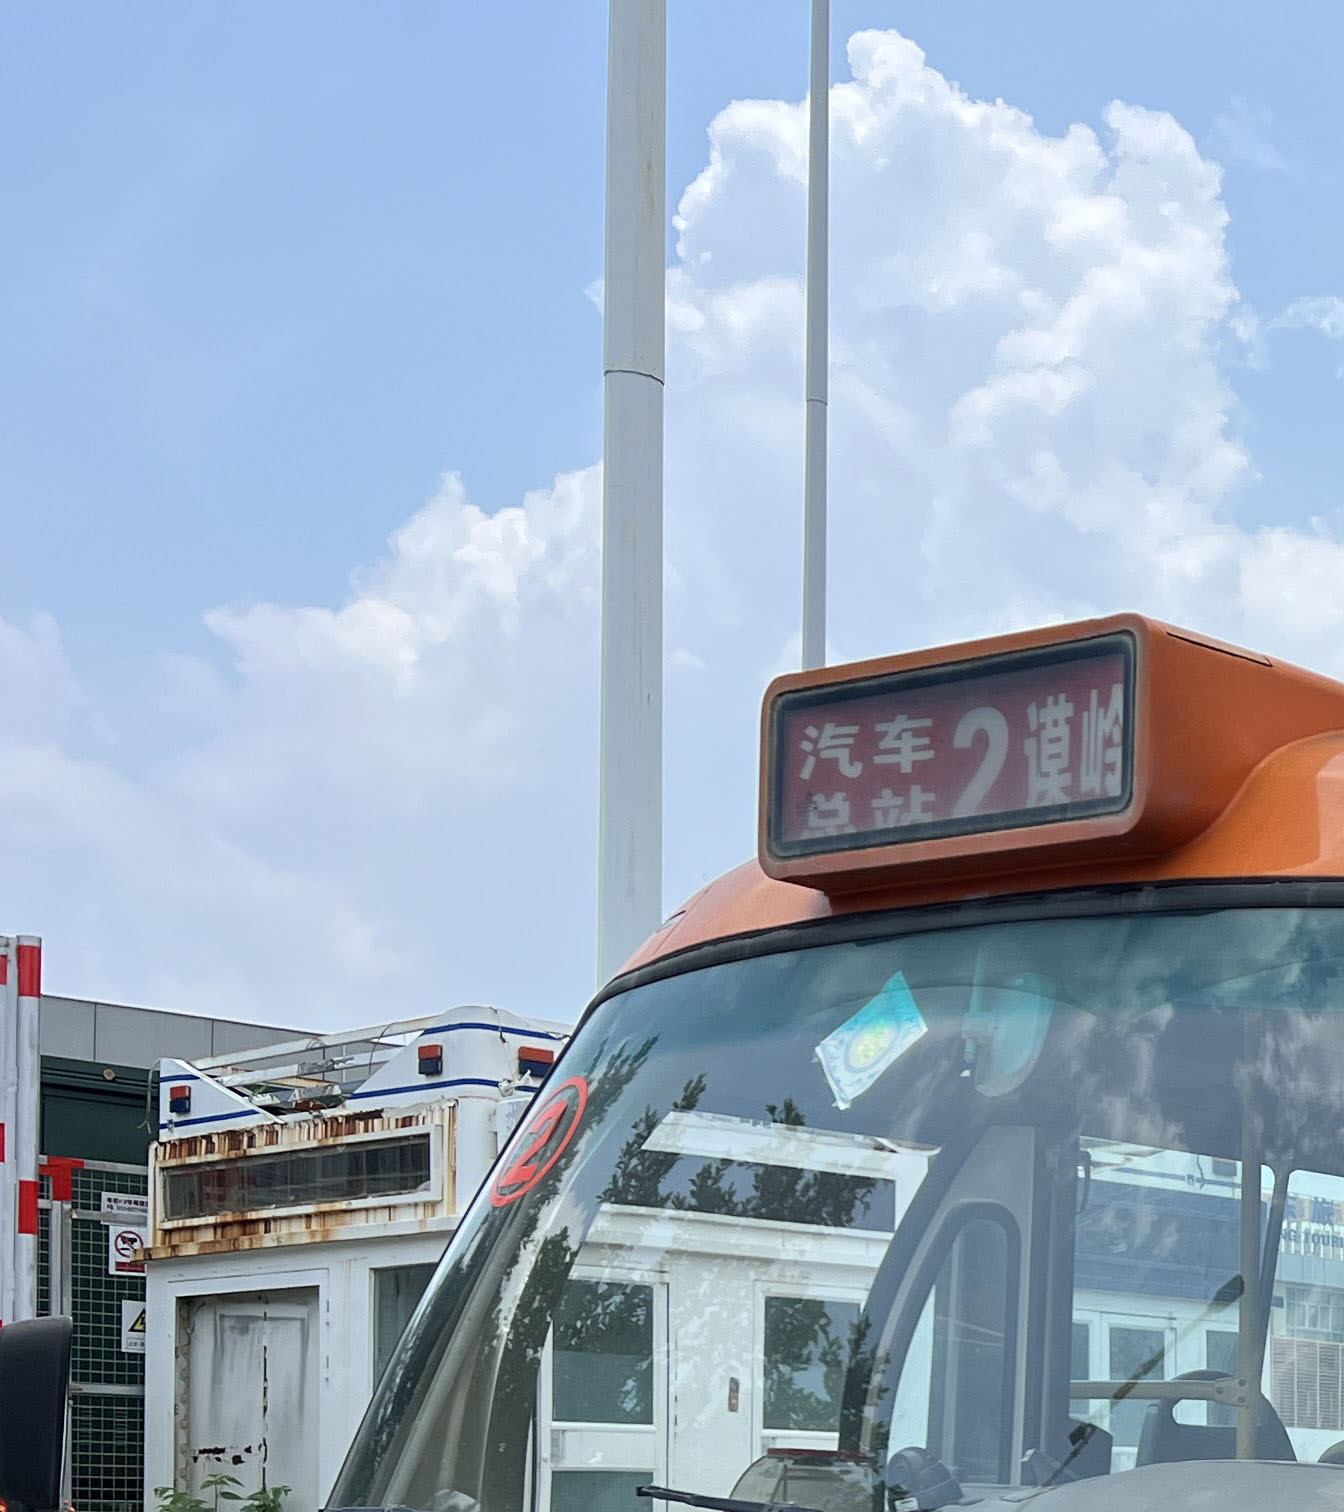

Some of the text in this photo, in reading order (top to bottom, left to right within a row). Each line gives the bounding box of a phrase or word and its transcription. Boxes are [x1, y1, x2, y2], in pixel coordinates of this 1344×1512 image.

[800, 714, 935, 780] 汽车
[952, 706, 1010, 818] 2
[800, 785, 936, 840] 总站
